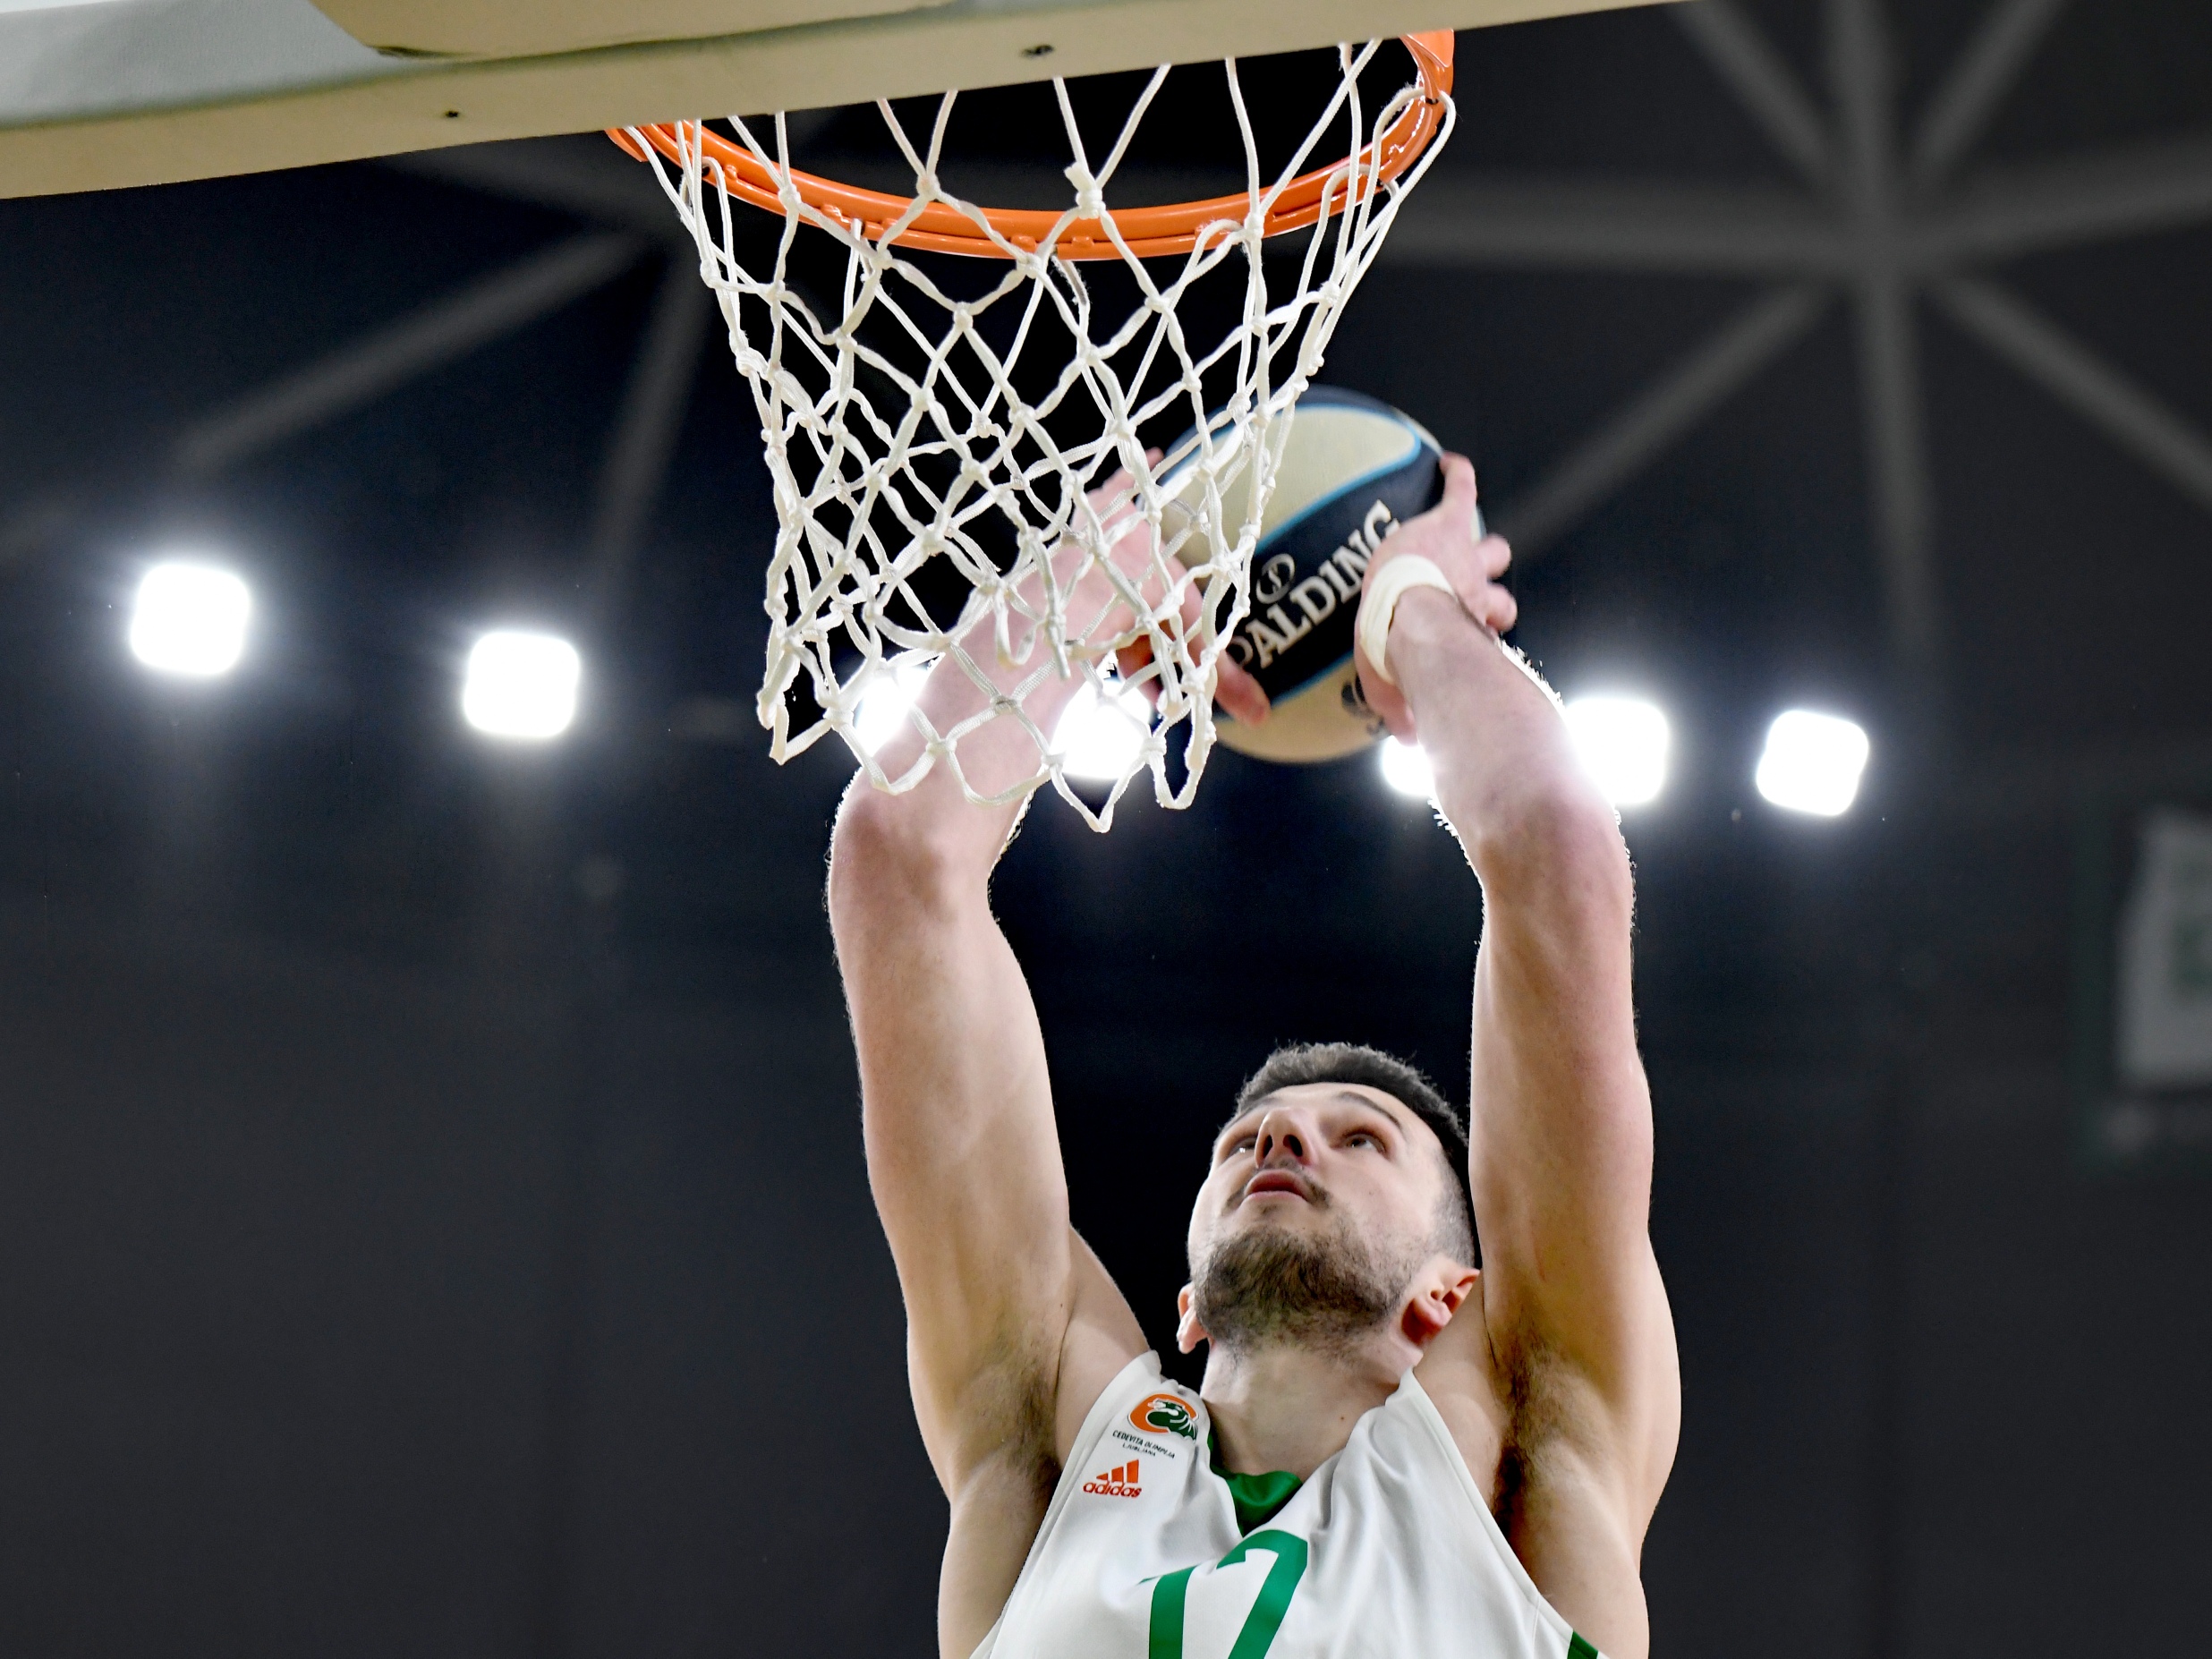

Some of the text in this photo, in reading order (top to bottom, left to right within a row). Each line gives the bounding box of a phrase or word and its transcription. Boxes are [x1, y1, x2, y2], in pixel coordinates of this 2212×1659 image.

[1227, 498, 1402, 669] PALDING
[1112, 1430, 1176, 1459] CEDEVITA OLIMPIJA
[1083, 1481, 1143, 1498] adidas
